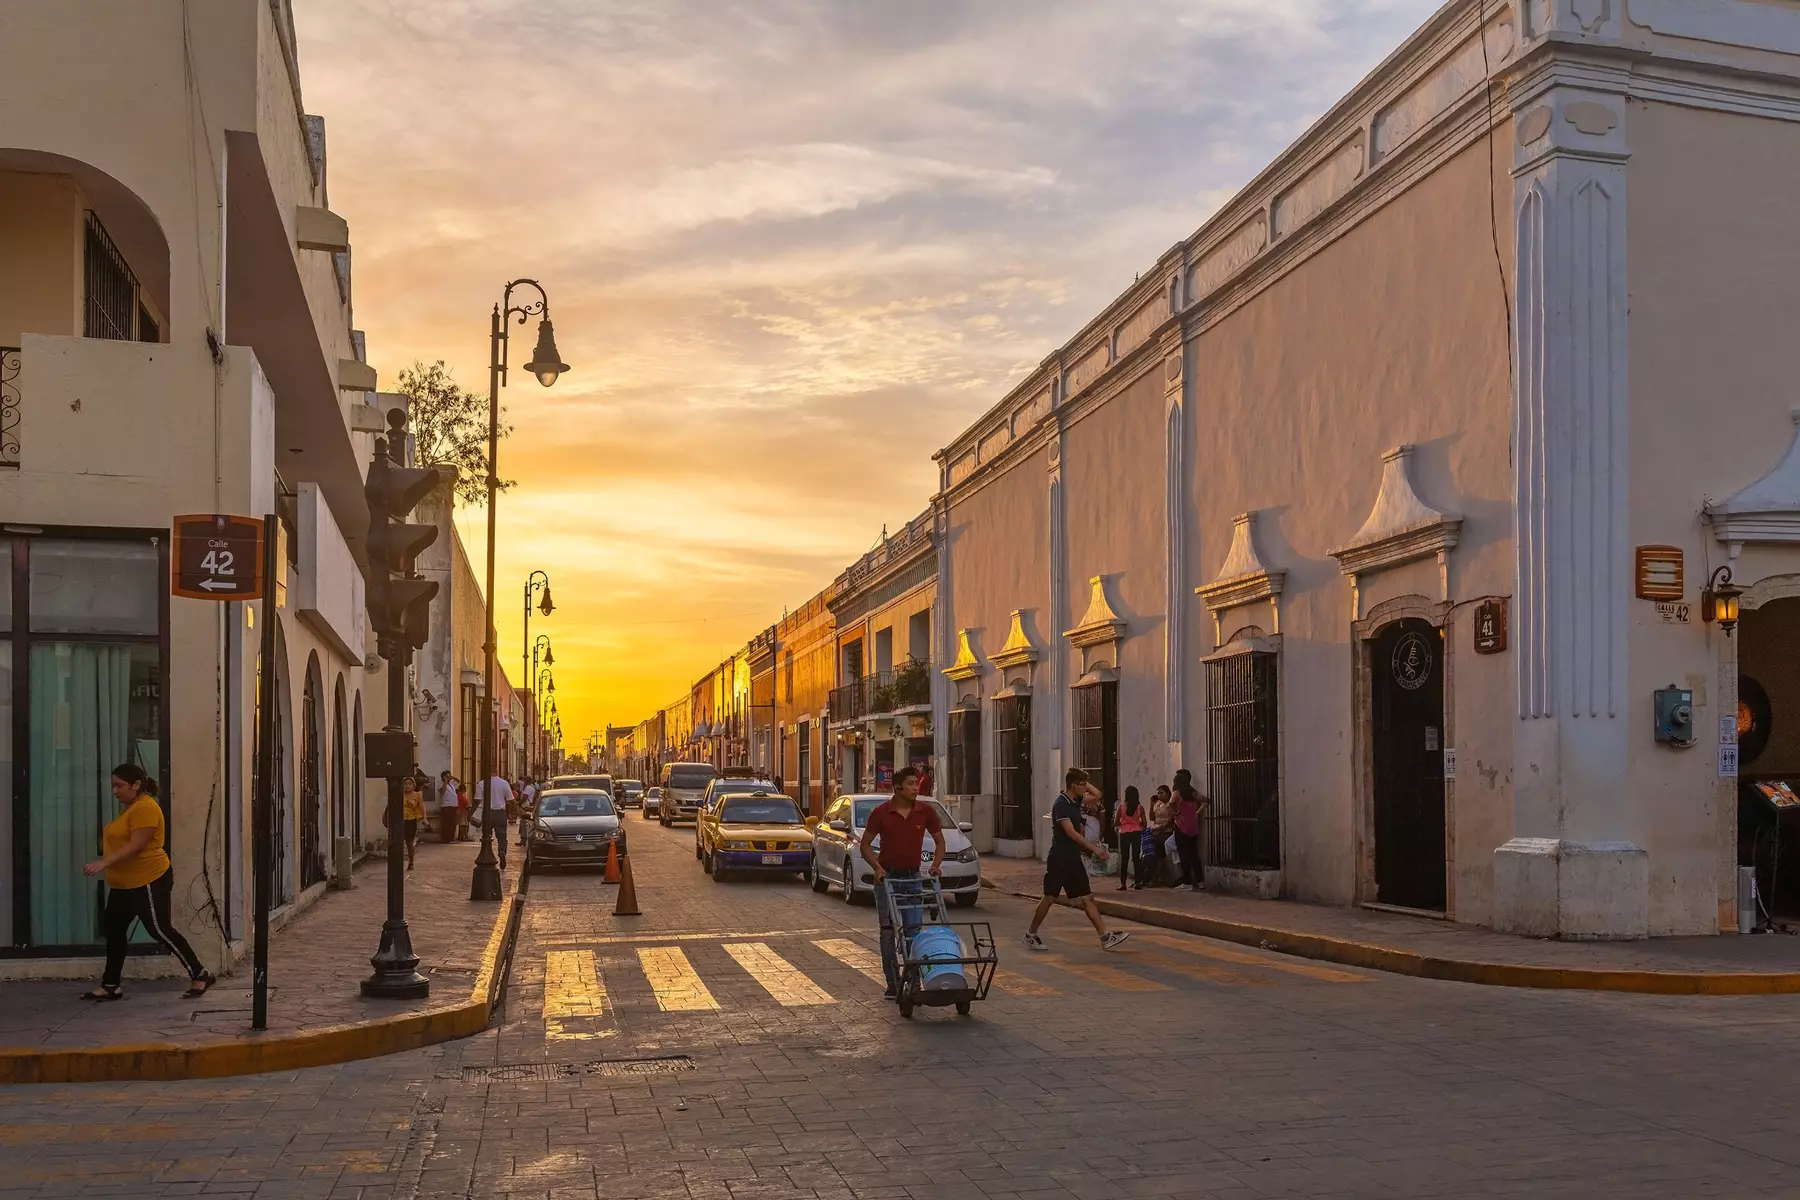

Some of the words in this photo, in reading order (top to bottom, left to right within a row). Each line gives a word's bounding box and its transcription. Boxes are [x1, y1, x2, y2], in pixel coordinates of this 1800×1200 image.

[207, 539, 229, 548] Calle
[201, 550, 234, 575] 42
[1676, 605, 1689, 622] 42
[1482, 620, 1494, 636] 41
